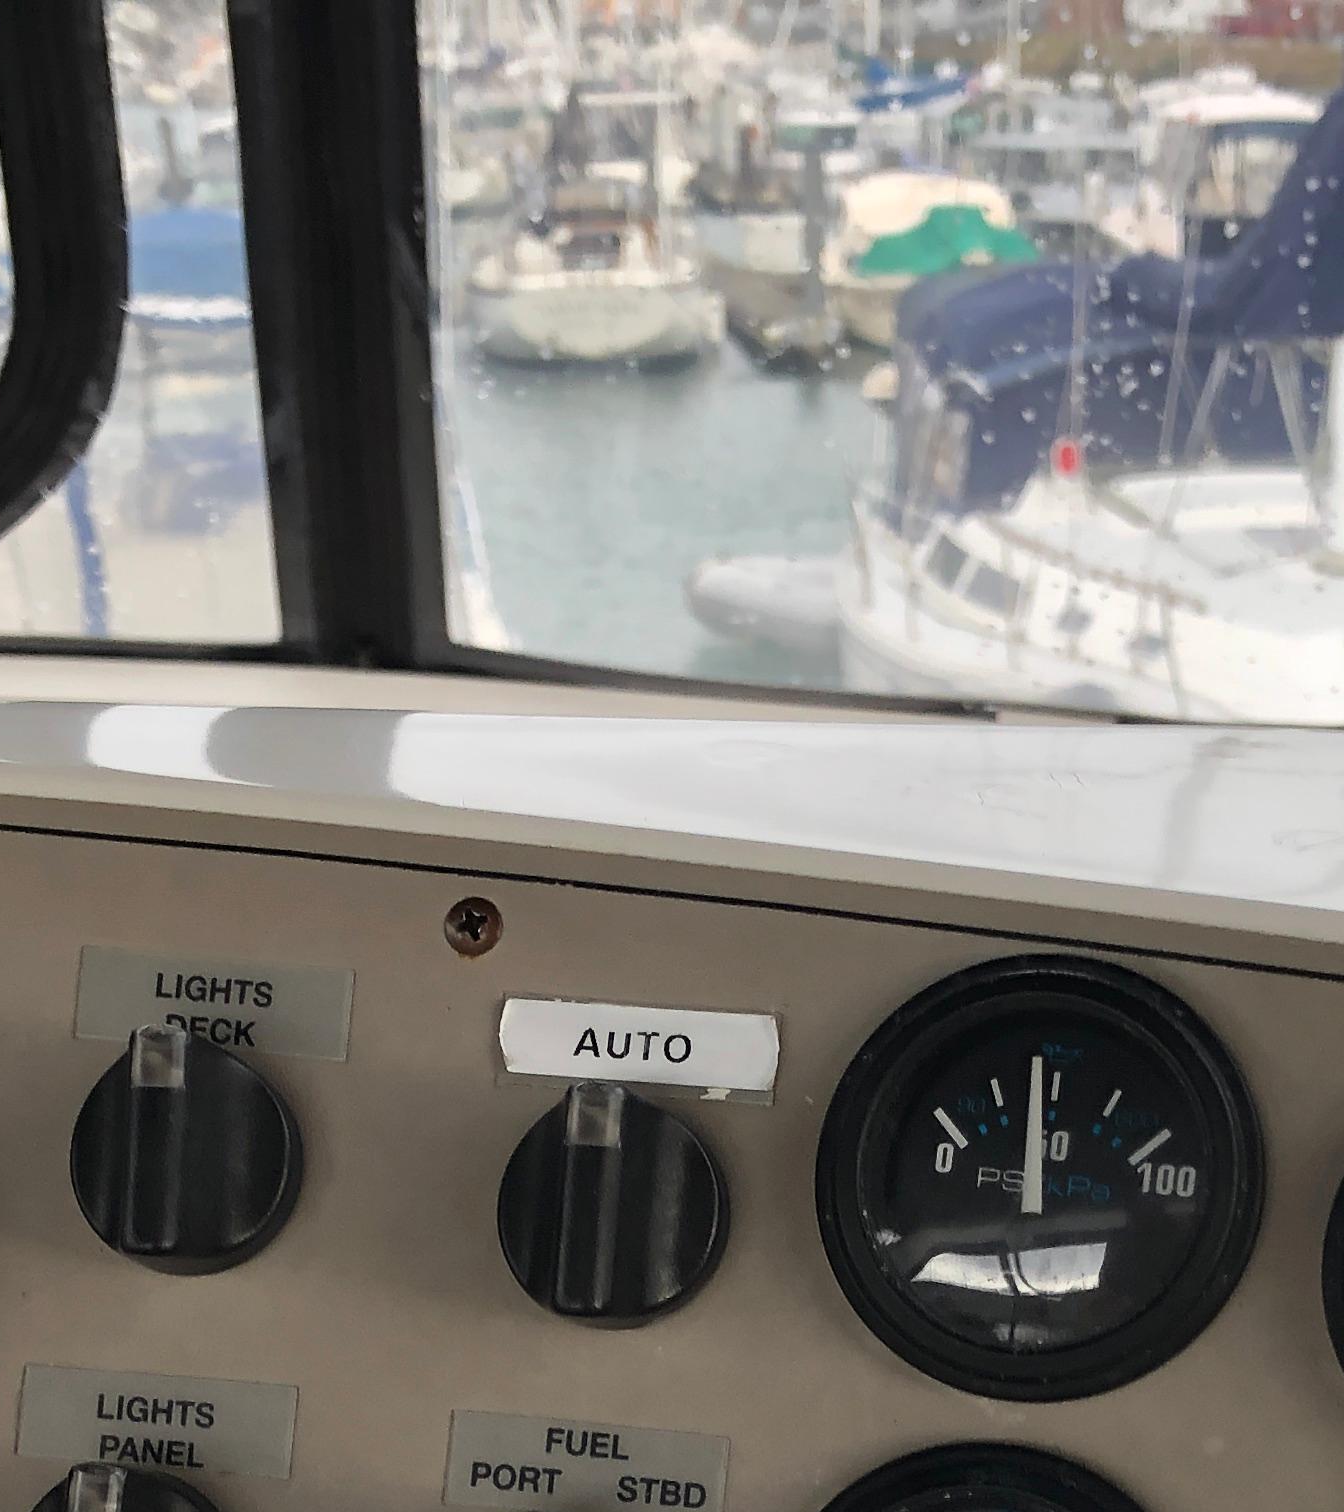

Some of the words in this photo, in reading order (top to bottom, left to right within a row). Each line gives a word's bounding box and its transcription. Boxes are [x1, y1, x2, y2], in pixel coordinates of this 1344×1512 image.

[155, 972, 274, 1009] LIGHTS
[573, 1028, 692, 1066] AUTO
[935, 1142, 954, 1174] 0
[977, 1166, 1025, 1193] PS
[1137, 1163, 1196, 1198] 100
[96, 1394, 216, 1429] LIGHTS
[98, 1435, 205, 1470] PANEL
[545, 1428, 630, 1461] FUEL
[470, 1462, 563, 1496] PORT
[615, 1475, 708, 1510] STBD
